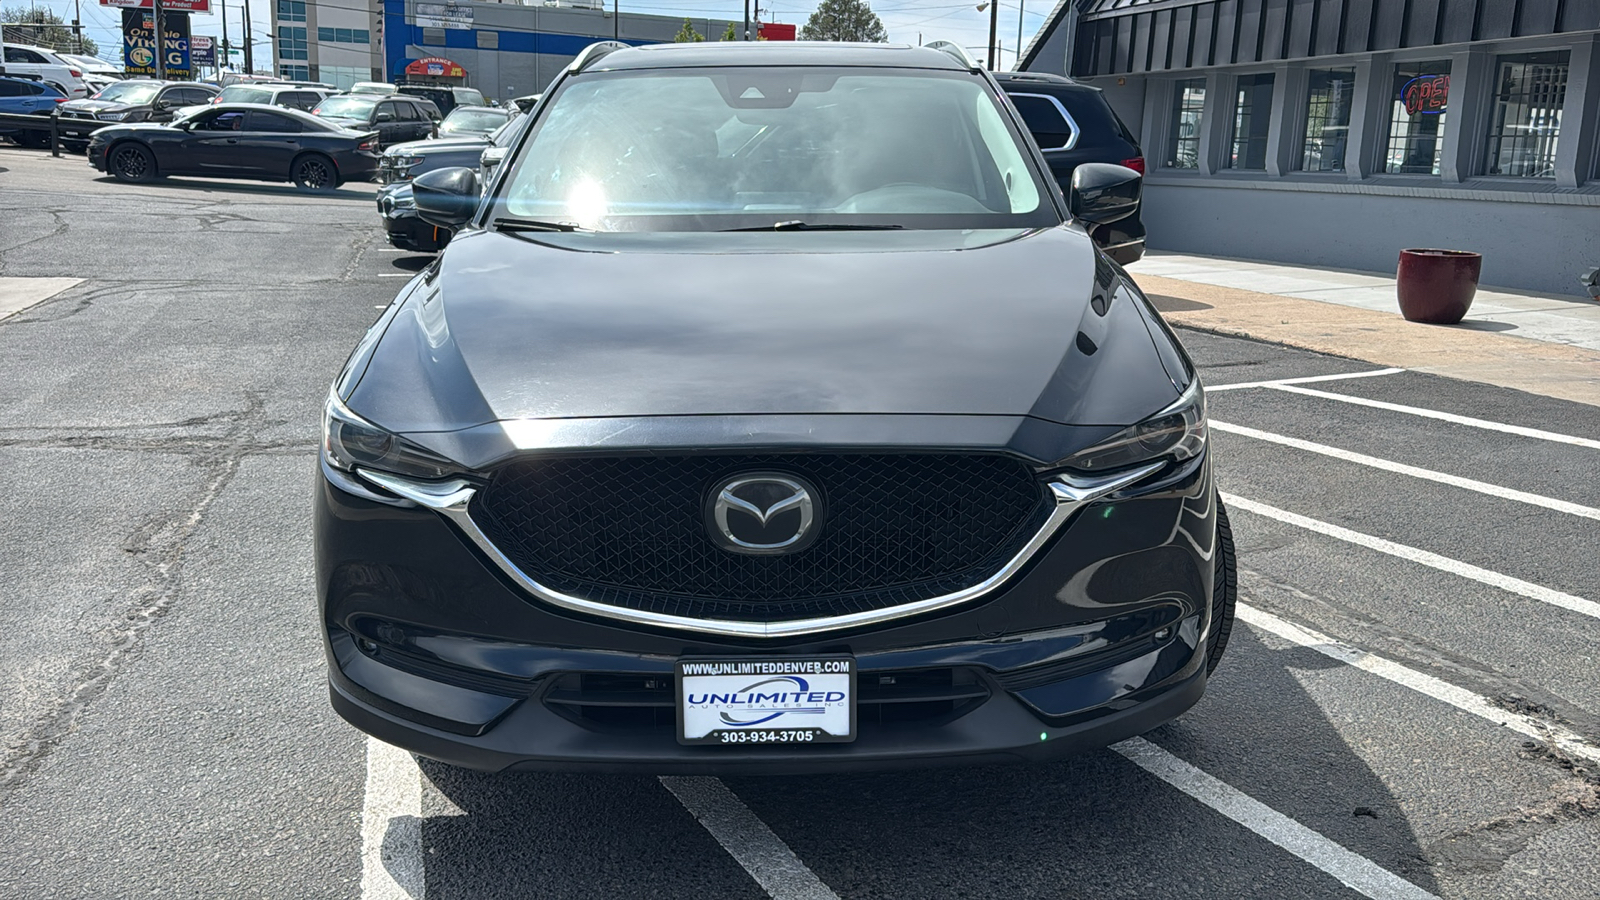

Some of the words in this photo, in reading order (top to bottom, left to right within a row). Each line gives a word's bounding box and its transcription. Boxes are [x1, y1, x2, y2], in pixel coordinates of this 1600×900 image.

[130, 28, 149, 37] On
[125, 36, 188, 51] VIKNG
[420, 58, 452, 66] ENTRANCE
[166, 68, 190, 77] elivery
[682, 661, 849, 675] WWWUNLIMITEDDENVER.COM
[688, 691, 846, 704] UNLIMITED
[721, 731, 813, 743] 303-934-3705
